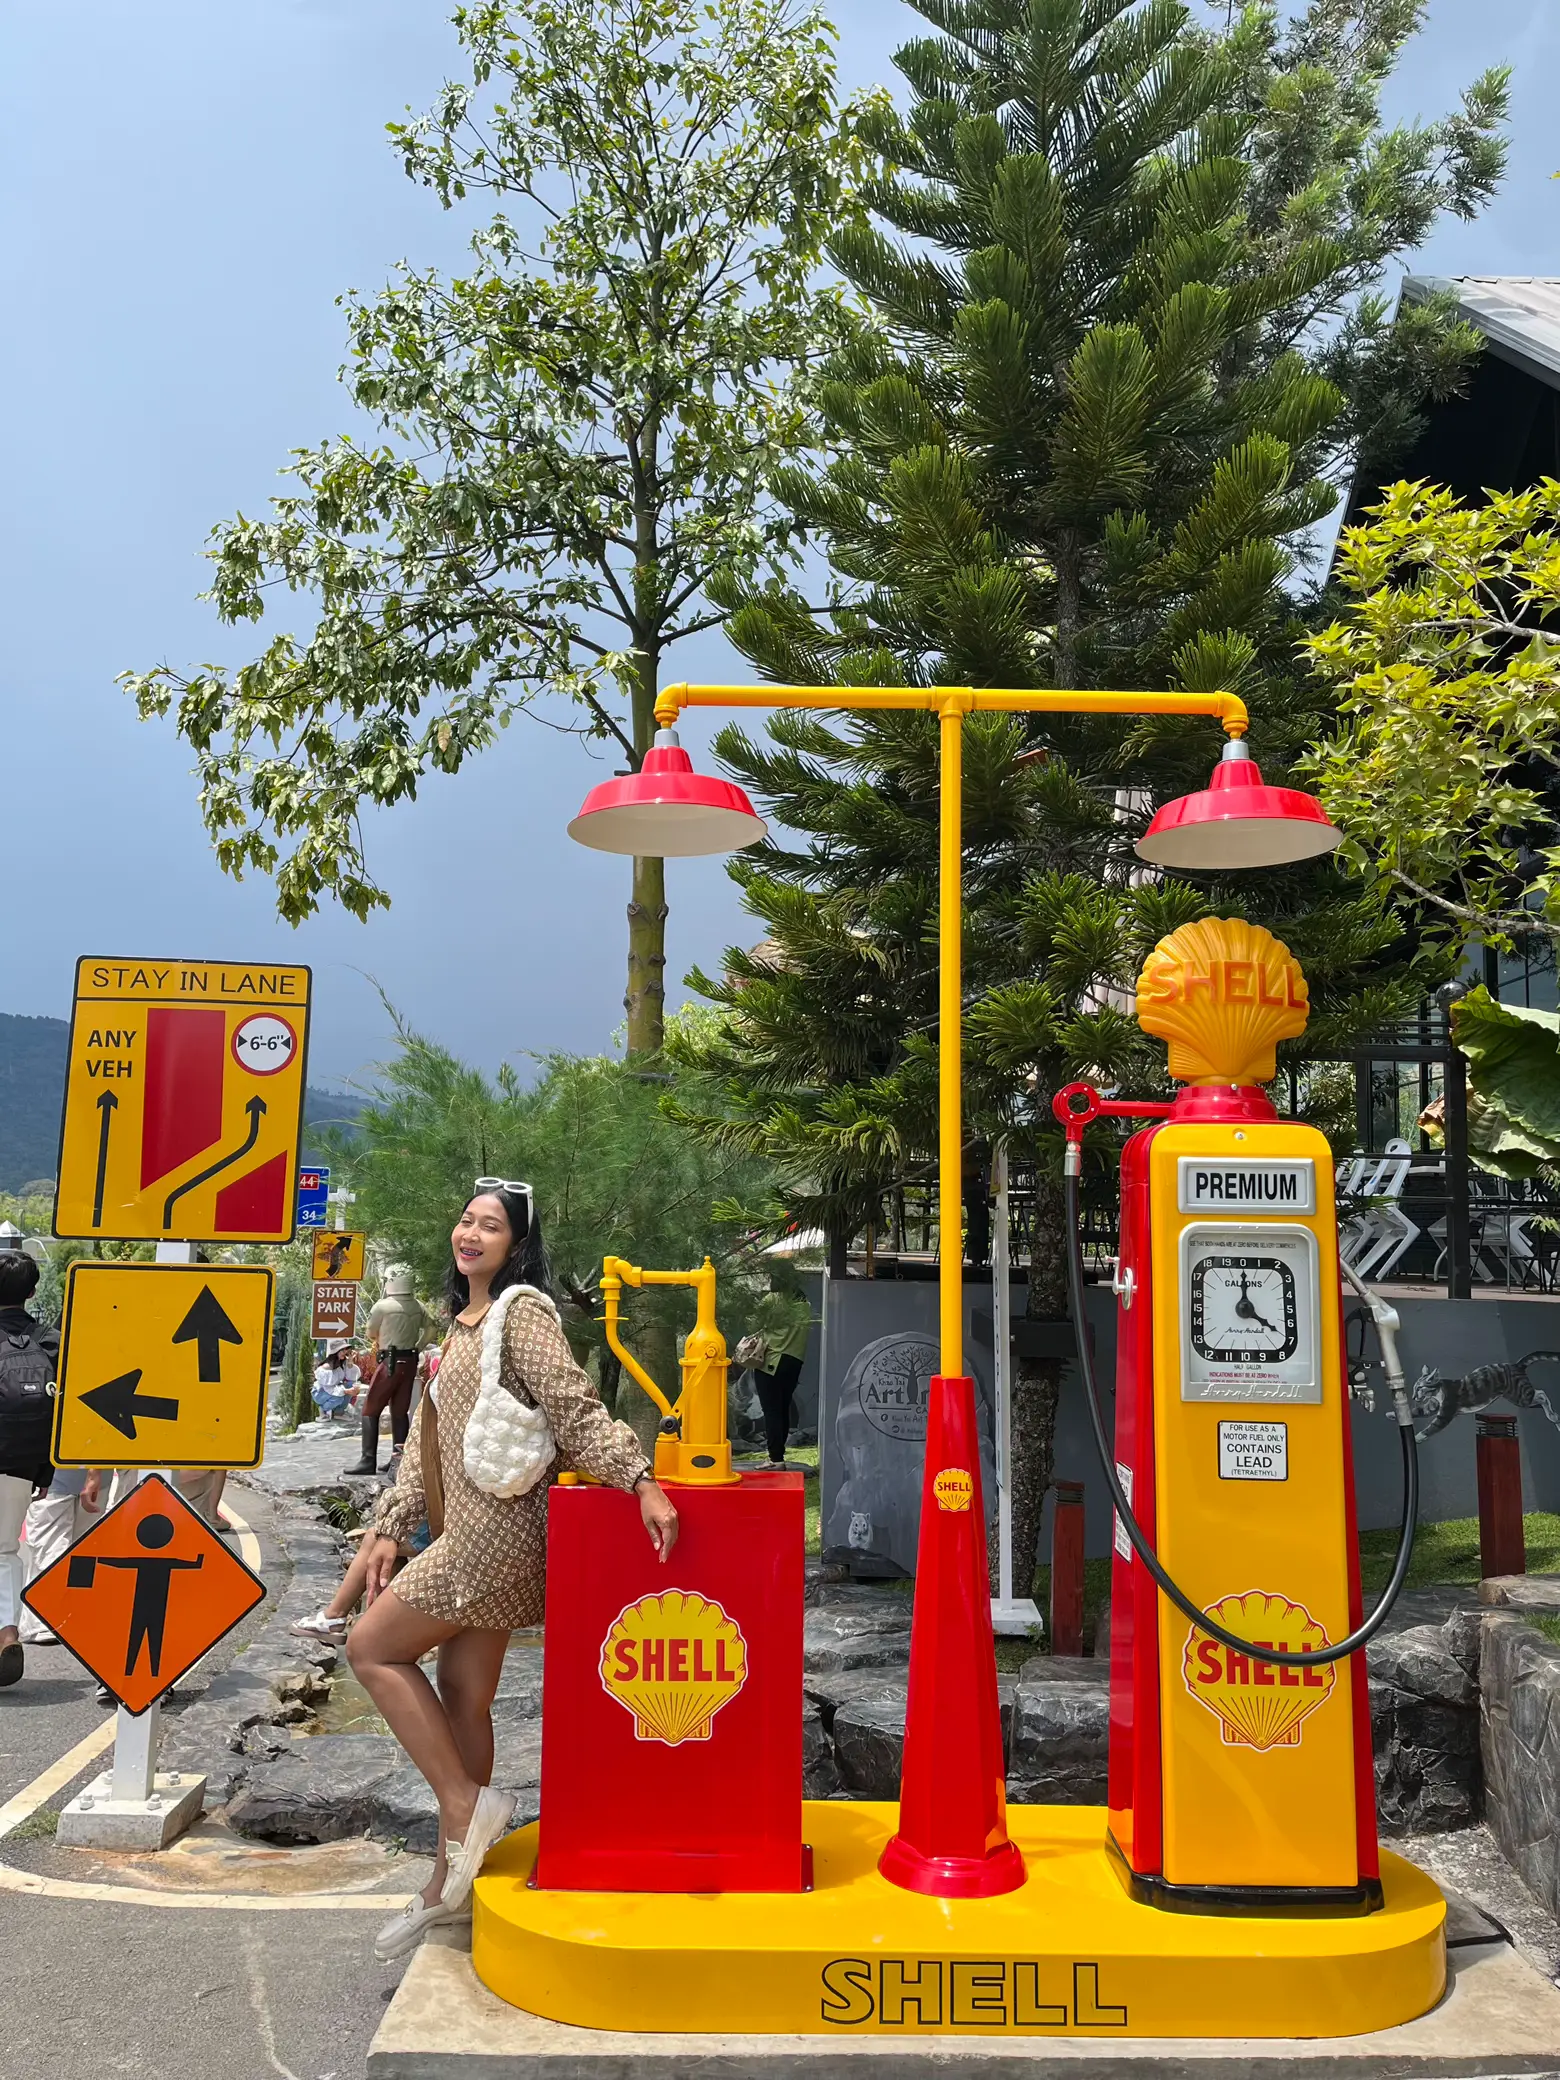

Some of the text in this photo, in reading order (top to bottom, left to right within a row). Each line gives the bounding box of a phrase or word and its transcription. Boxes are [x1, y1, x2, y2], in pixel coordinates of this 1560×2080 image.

[91, 967, 296, 995] STAY IN LANE
[1149, 959, 1307, 1010] SHELL
[87, 1029, 137, 1048] ANY
[86, 1059, 133, 1078] VEH
[1195, 1172, 1297, 1200] PREMIUM
[302, 1210, 316, 1220] 34
[1203, 1260, 1213, 1268] 18
[1222, 1258, 1232, 1266] 19
[1240, 1258, 1247, 1267] 0
[1274, 1260, 1281, 1269] 2
[1193, 1272, 1202, 1281] 17
[1285, 1274, 1292, 1283] 3
[1224, 1280, 1263, 1288] GALONS
[317, 1287, 354, 1299] STATE
[1193, 1290, 1202, 1298] 16
[1286, 1290, 1293, 1299] 4
[317, 1302, 350, 1314] PARK
[1193, 1304, 1202, 1312] 15
[1286, 1305, 1294, 1314] 5
[1193, 1317, 1202, 1326] 14
[1287, 1319, 1294, 1328] 6
[1193, 1334, 1203, 1344] 13
[1288, 1336, 1295, 1346] 7
[1204, 1350, 1286, 1361] 12 11 10 9 8
[865, 1383, 904, 1404] Art
[1227, 1443, 1282, 1454] CONTAINS
[1236, 1456, 1272, 1468] LEAD
[1231, 1469, 1277, 1477] (TETRAETHYL)
[937, 1482, 971, 1492] SHELL
[612, 1638, 736, 1682] SHELL
[1196, 1639, 1324, 1687] SHELL
[820, 1958, 1128, 2027] SHELL
